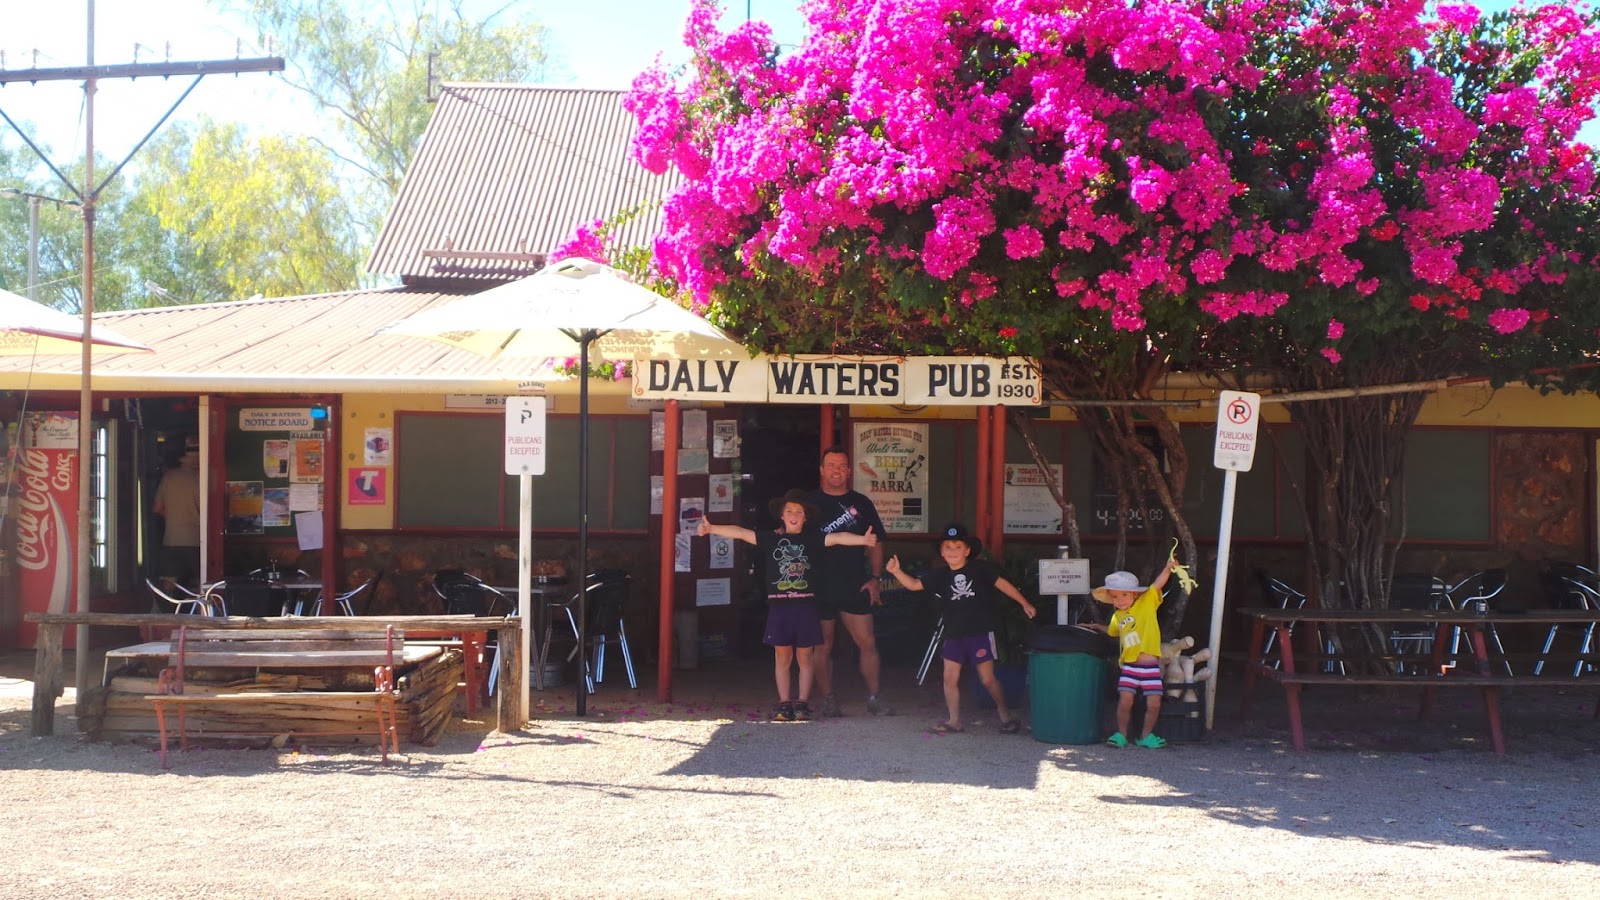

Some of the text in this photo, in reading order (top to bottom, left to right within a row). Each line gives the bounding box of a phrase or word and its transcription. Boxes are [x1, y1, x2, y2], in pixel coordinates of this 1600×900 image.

[1001, 363, 1038, 380] EST.
[648, 359, 991, 398] DALY WATERS PUB
[997, 384, 1035, 398] 1930
[244, 418, 309, 427] NOTICE BOARD
[507, 436, 543, 445] PUBLICANS
[1219, 430, 1254, 441] PUBLICANS
[509, 447, 541, 456] EXCEPTED
[865, 442, 915, 454] World Famous
[1220, 441, 1251, 452] EXCEPTED
[874, 455, 908, 468] BEEF
[870, 480, 914, 493] BARRA
